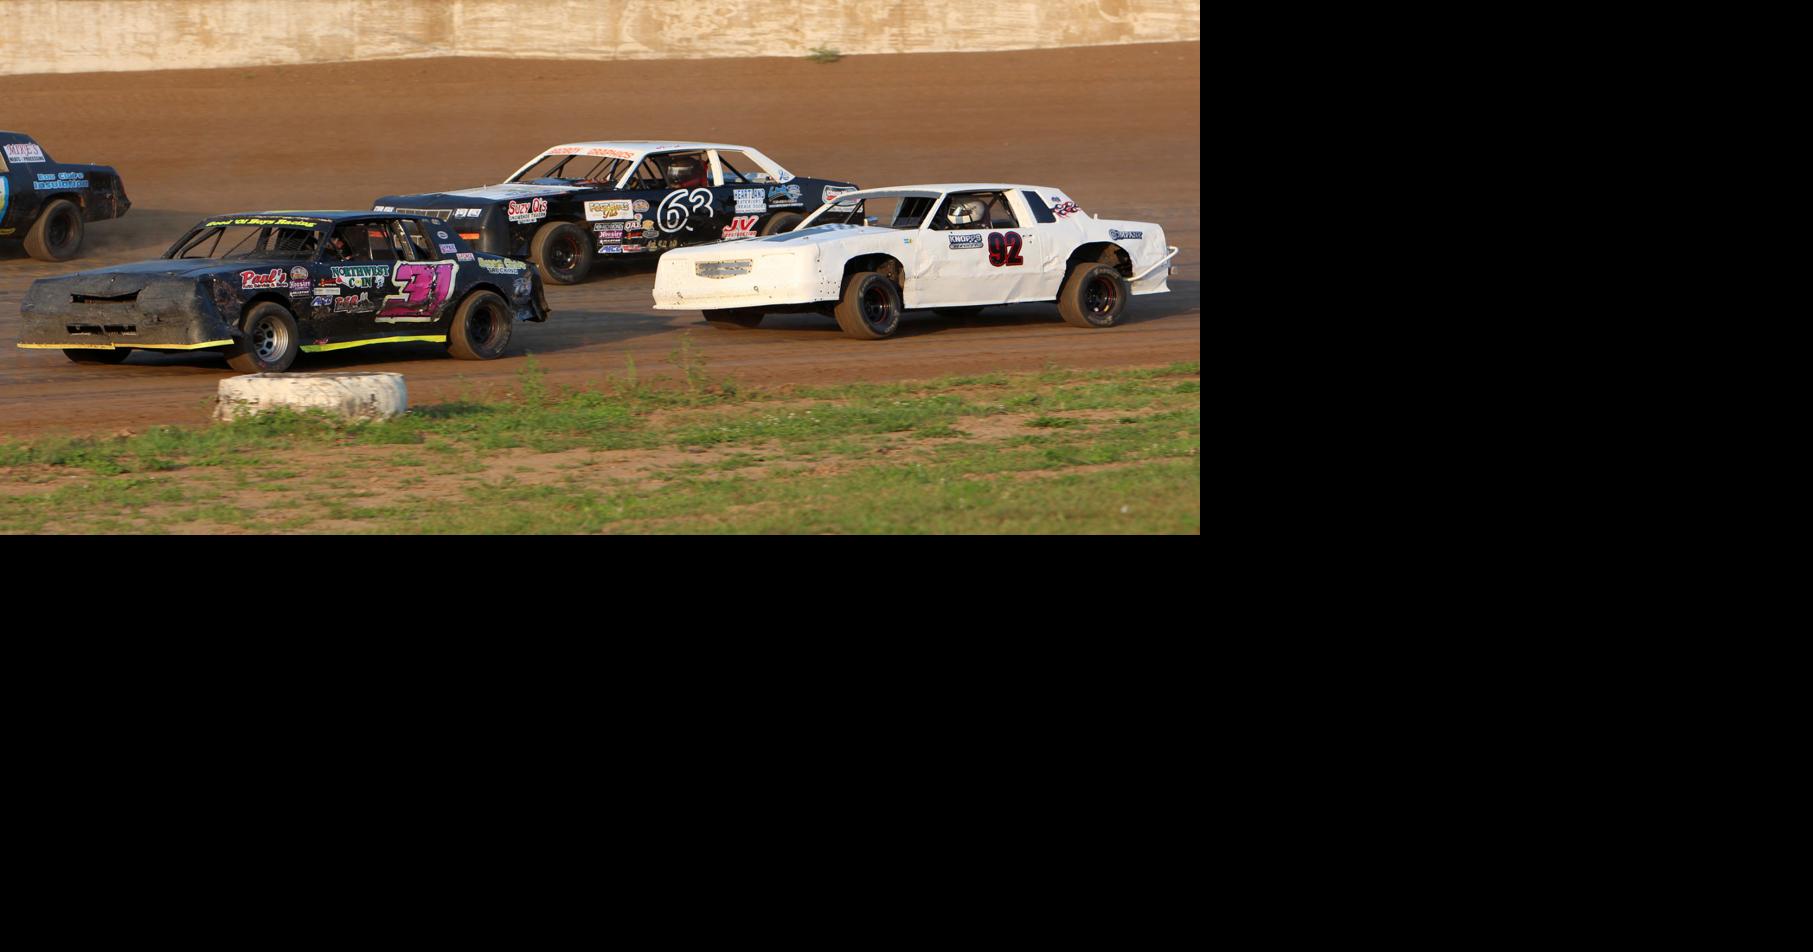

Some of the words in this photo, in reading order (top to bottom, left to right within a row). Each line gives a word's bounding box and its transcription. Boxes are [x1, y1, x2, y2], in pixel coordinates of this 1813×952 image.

[656, 187, 713, 233] 63
[274, 219, 317, 228] Racing
[723, 215, 759, 232] JV
[987, 231, 1023, 267] 92
[240, 269, 287, 285] Paul's
[331, 266, 389, 278] NORTHWEST
